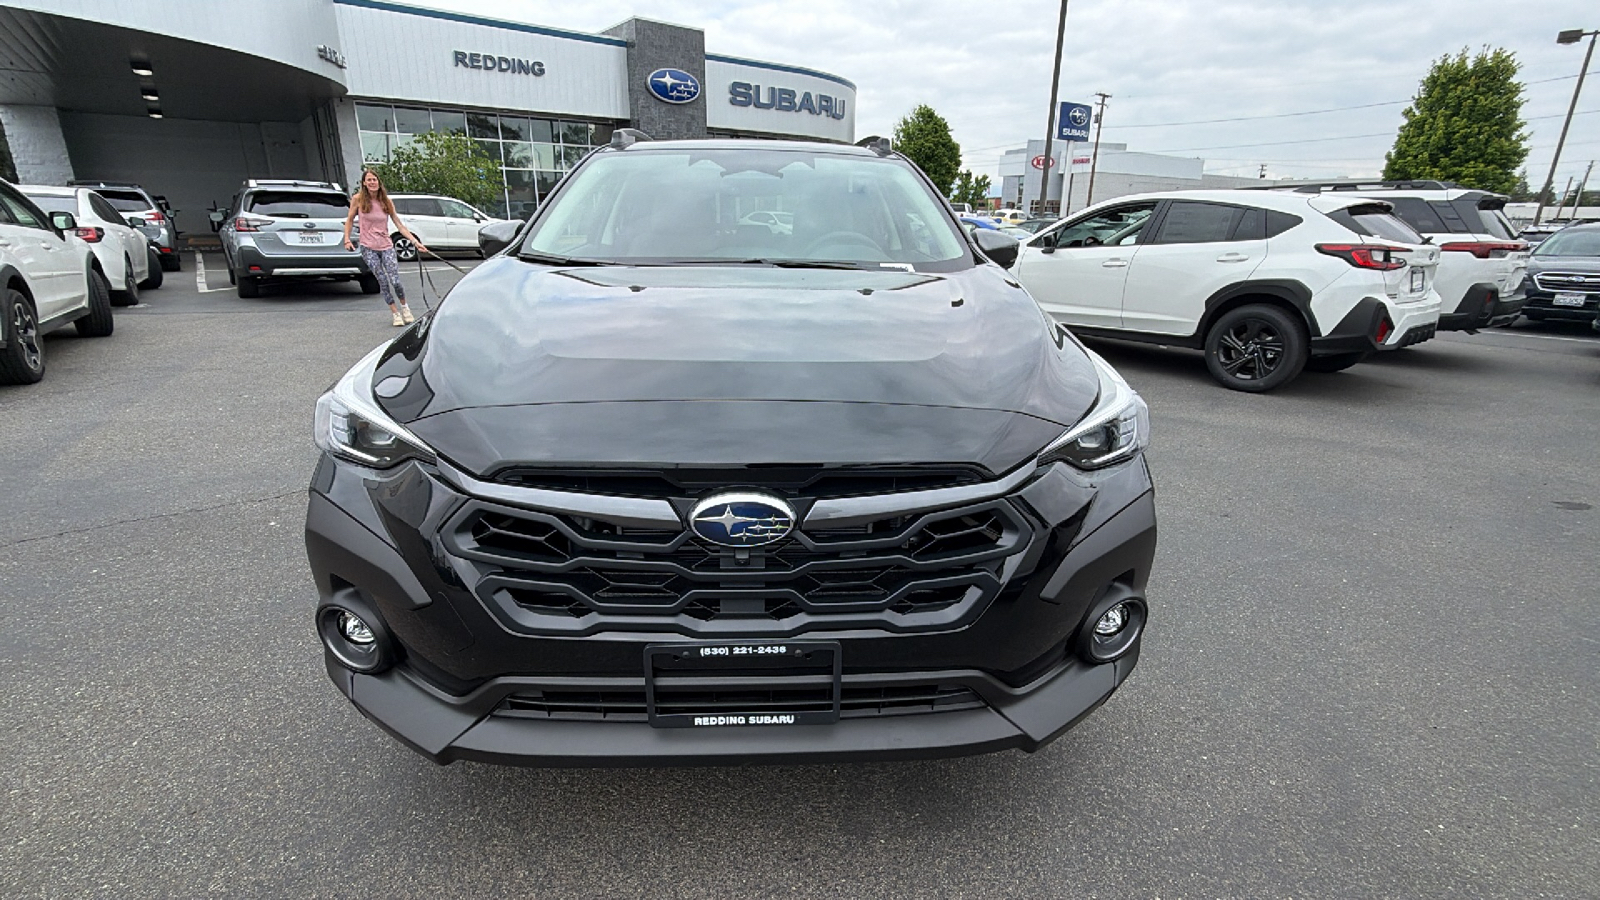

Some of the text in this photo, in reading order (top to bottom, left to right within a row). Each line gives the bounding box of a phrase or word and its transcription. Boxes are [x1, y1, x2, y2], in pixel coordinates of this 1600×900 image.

[453, 50, 545, 76] REDDING
[730, 81, 845, 120] SUBARU
[1062, 128, 1088, 138] SUBARU
[700, 647, 729, 657] (530)
[694, 715, 795, 726] REDDING SUBARU
